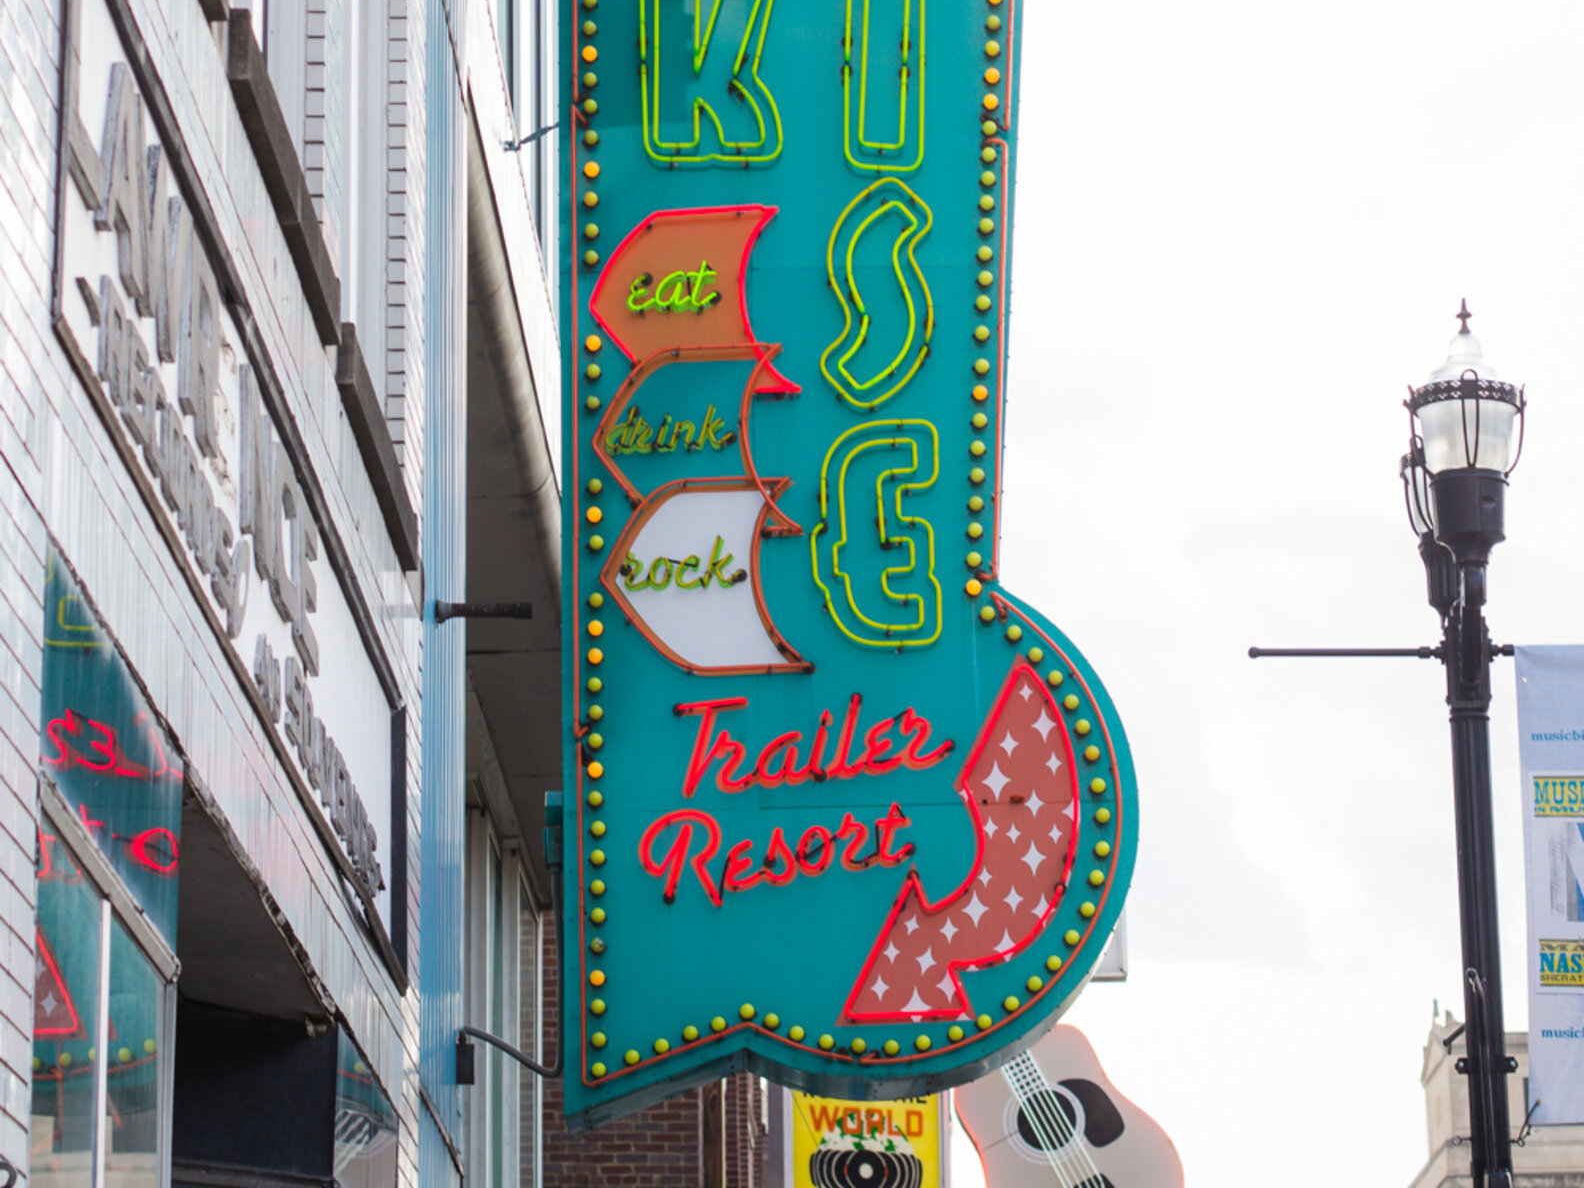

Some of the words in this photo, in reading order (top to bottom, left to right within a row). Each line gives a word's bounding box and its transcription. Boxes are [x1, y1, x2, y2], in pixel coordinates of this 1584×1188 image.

[627, 260, 721, 311] eat
[606, 404, 737, 454] drink
[620, 535, 746, 591] rock
[673, 692, 956, 798] Trailer
[638, 803, 915, 908] Resort
[1539, 952, 1584, 974] NAS
[809, 1104, 924, 1138] WORLD
